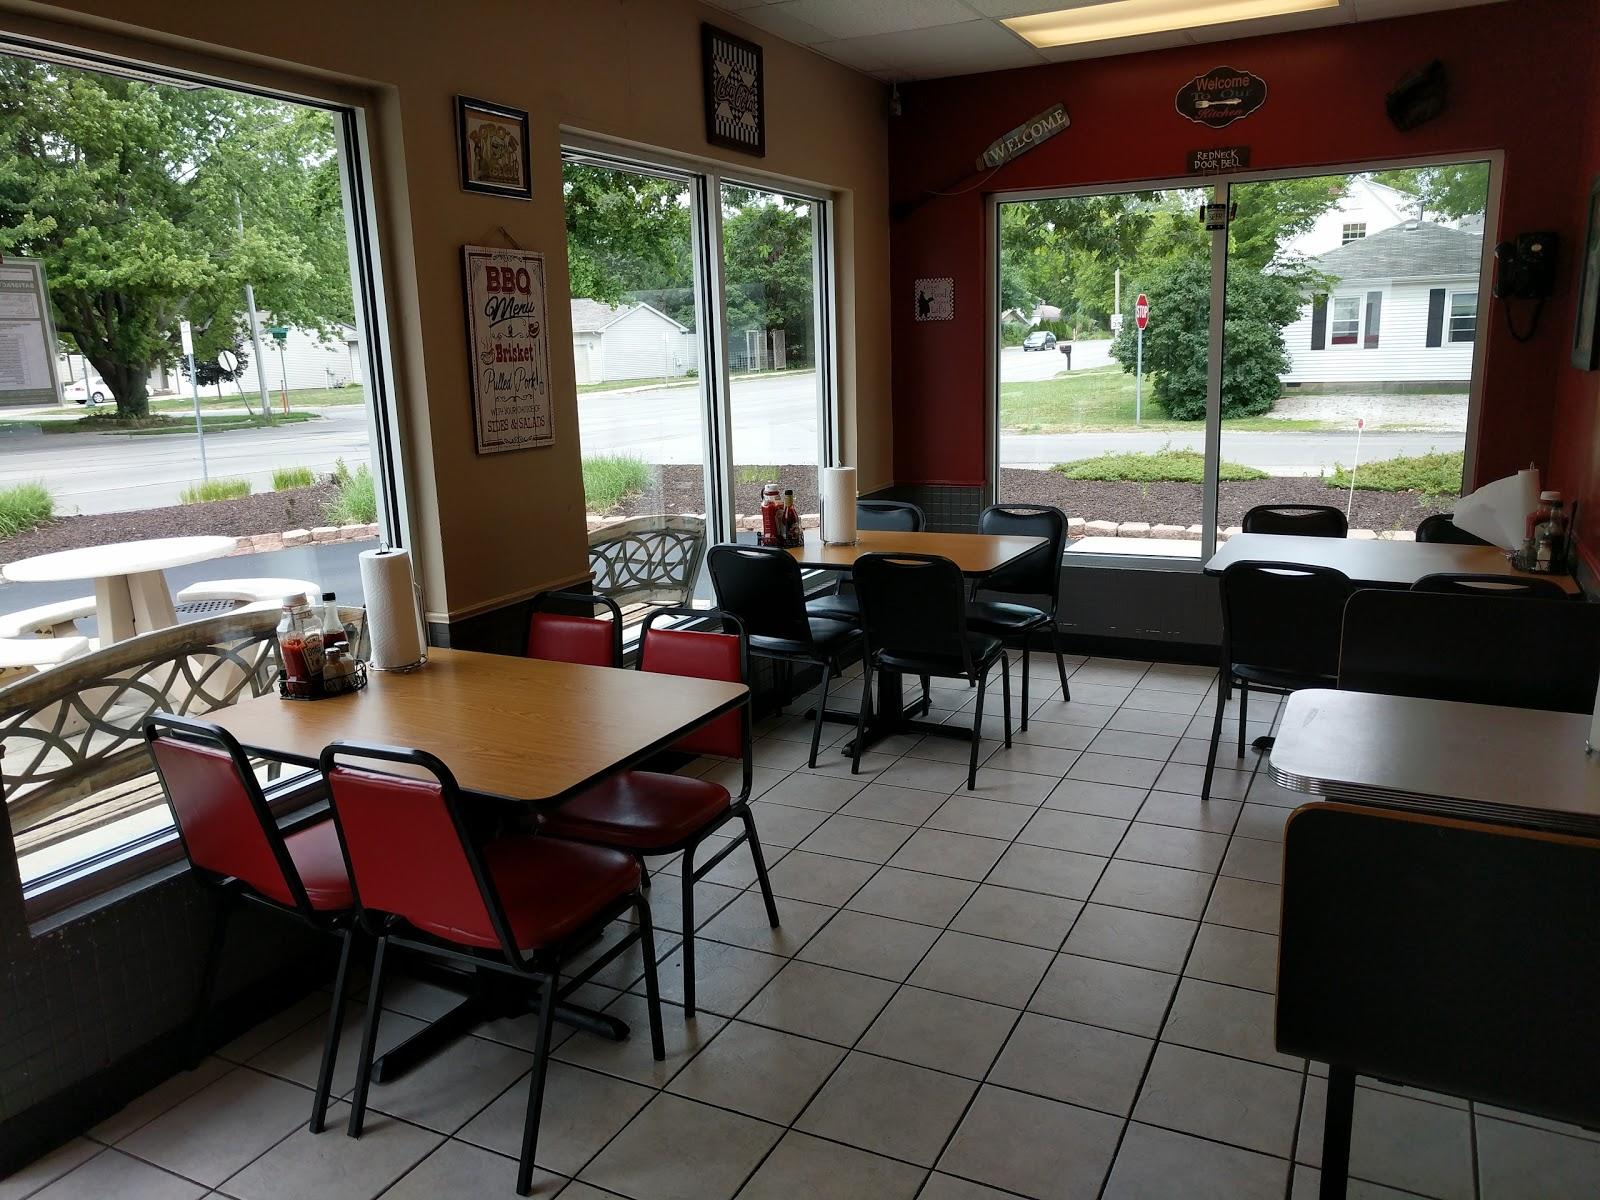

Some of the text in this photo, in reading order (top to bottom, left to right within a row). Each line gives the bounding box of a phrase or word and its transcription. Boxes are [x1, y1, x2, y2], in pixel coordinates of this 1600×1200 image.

[1196, 76, 1250, 91] Welcome
[1195, 106, 1244, 119] Kitchen
[988, 109, 1066, 160] WELCOME
[1197, 149, 1239, 160] REDNECK
[1194, 158, 1243, 169] DOOR BELL
[485, 266, 531, 296] BBQ
[485, 296, 535, 322] Menu
[1136, 305, 1148, 319] STOP
[495, 343, 533, 363] Brisket
[484, 367, 512, 394] Pulled
[487, 415, 545, 432] SIDES & SALADS
